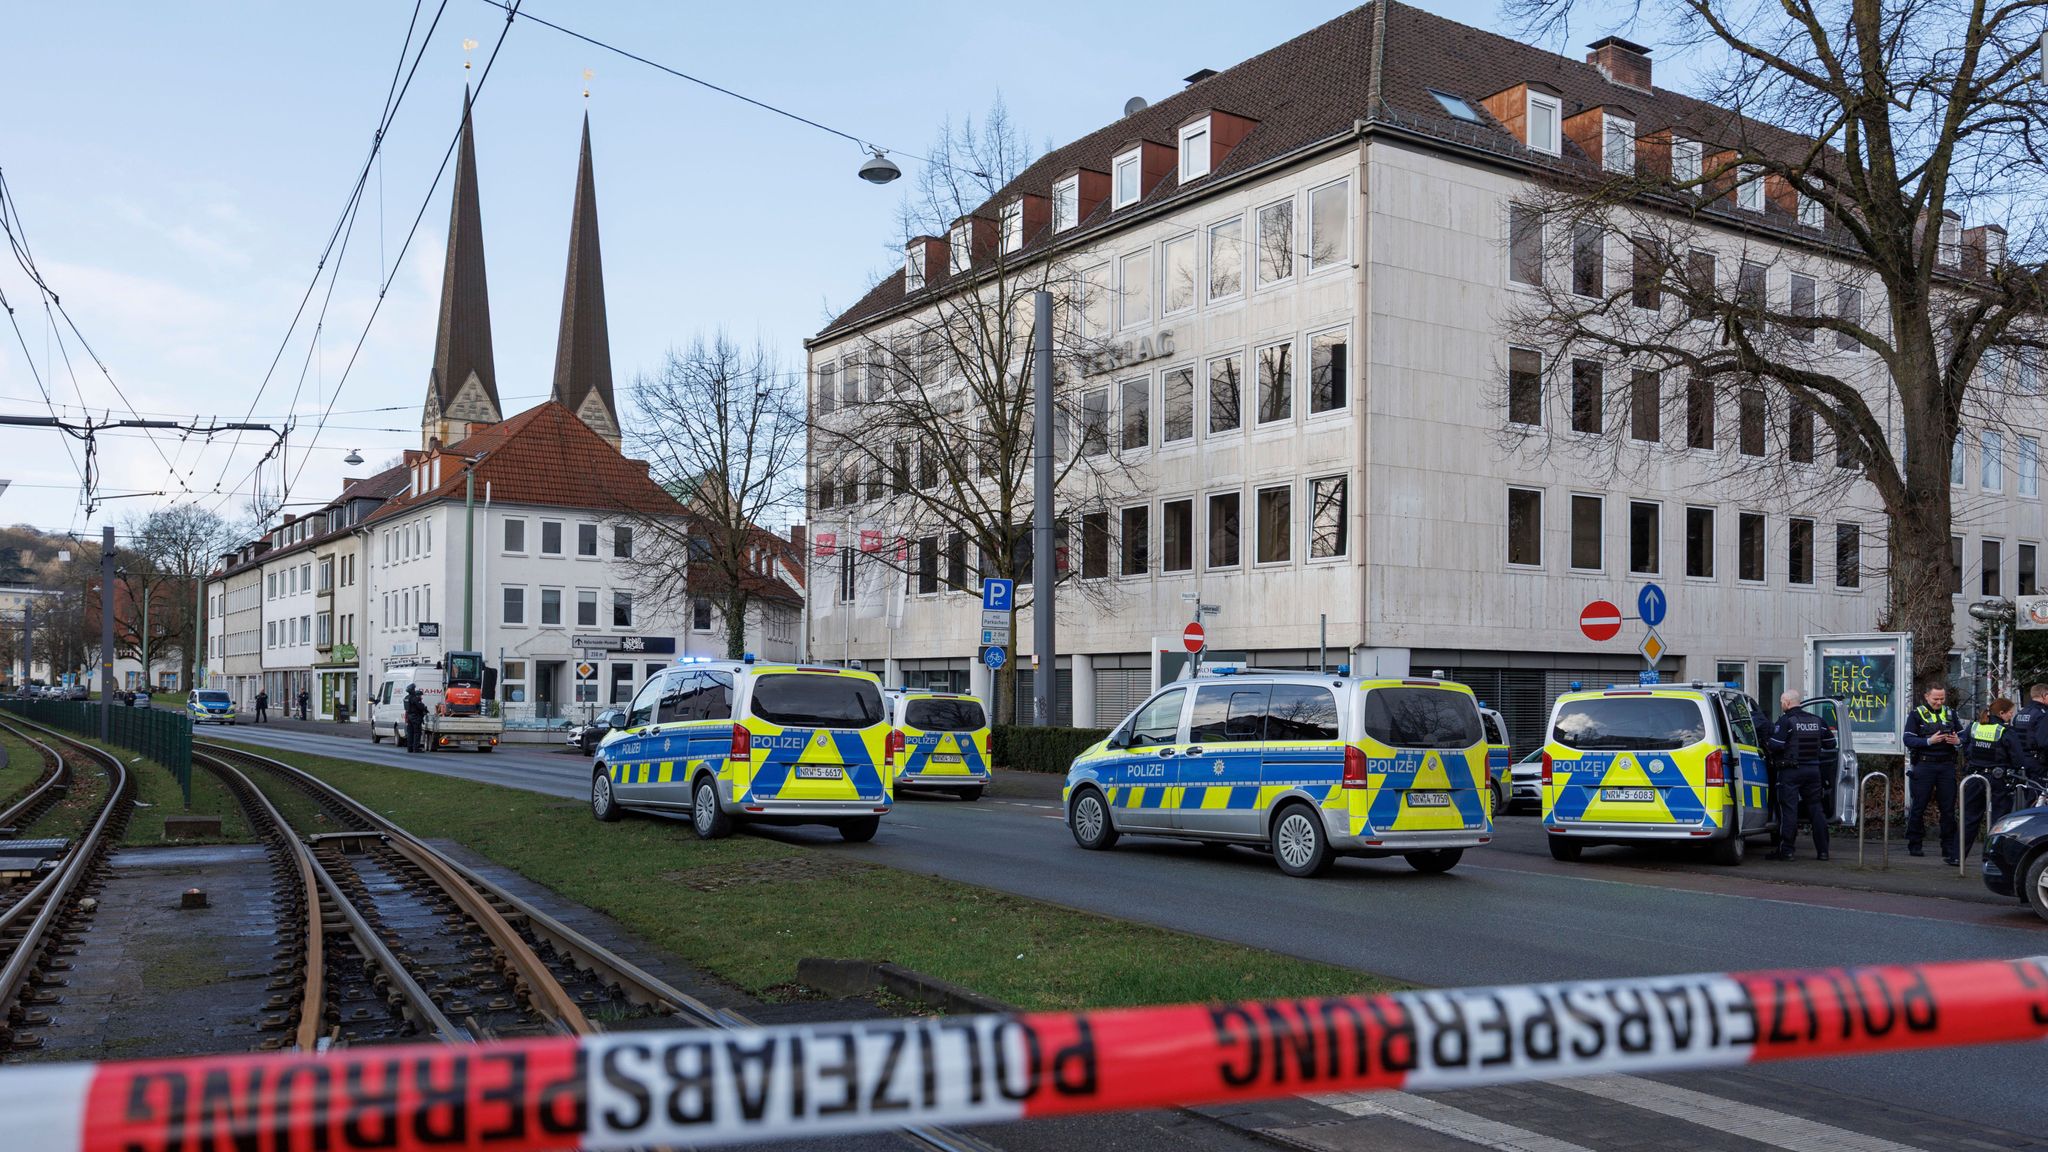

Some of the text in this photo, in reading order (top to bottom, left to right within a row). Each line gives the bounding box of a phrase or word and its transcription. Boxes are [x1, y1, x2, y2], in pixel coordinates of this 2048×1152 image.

[990, 583, 1005, 606] P
[1832, 665, 1872, 679] ELEC
[1832, 680, 1868, 693] TRIC
[1796, 722, 1819, 731] POLIZEI
[752, 736, 805, 749] POLIZEI
[906, 736, 938, 745] POLIZEI
[1975, 741, 1992, 749] NRW
[622, 742, 641, 754] POLIZEI
[1127, 763, 1165, 777] POLIZEI
[1368, 759, 1417, 773] POLIZEI
[1553, 760, 1606, 772] POLIZEI
[1605, 791, 1654, 800] NRW 5-6083
